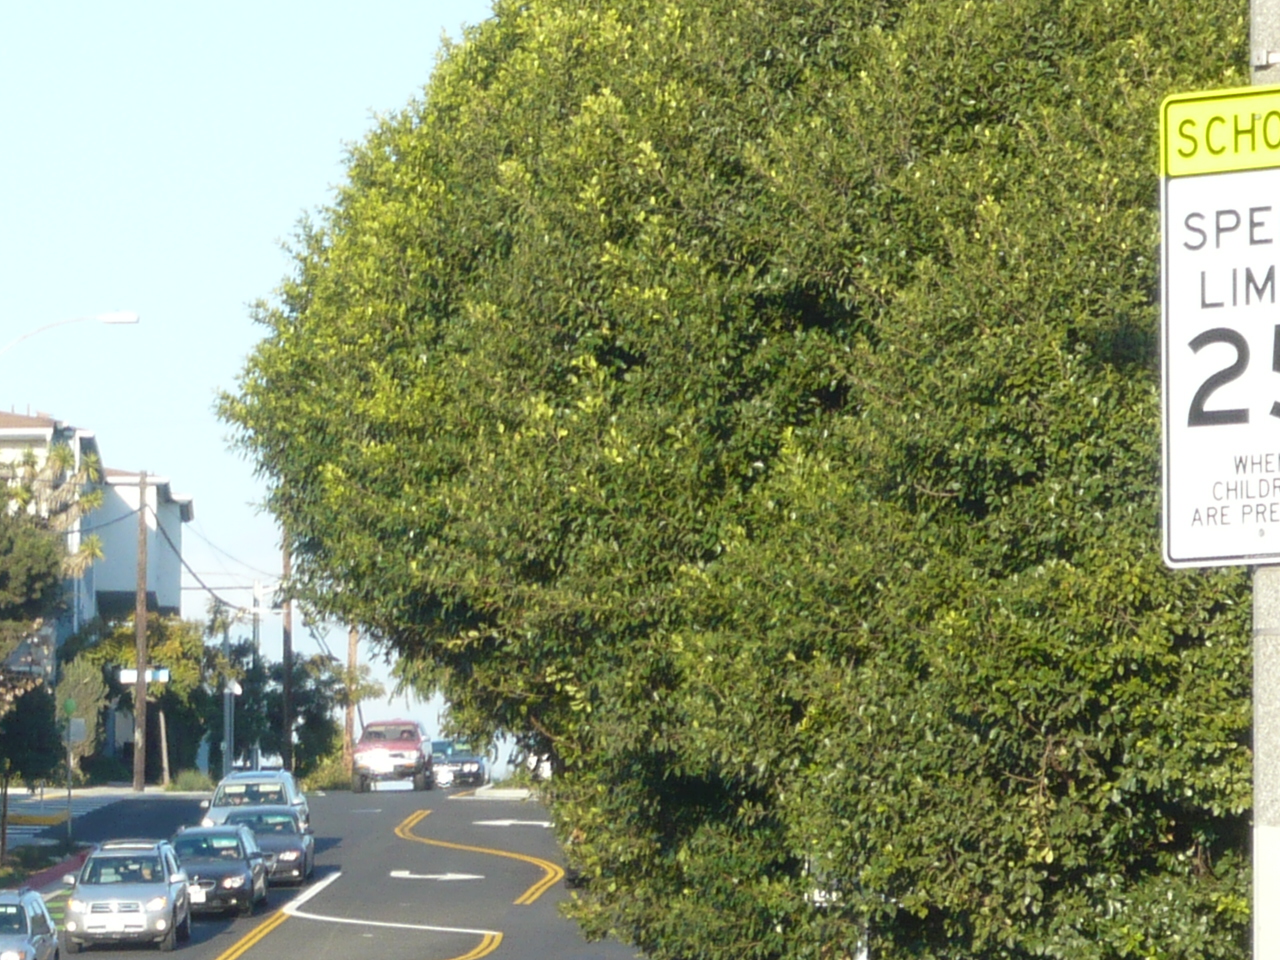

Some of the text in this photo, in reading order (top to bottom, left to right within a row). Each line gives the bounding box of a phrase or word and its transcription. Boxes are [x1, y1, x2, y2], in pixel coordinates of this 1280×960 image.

[1177, 110, 1280, 158] SCHO
[1183, 205, 1274, 252] SPE
[1200, 264, 1276, 310] LIM
[1187, 324, 1280, 428] 2
[1234, 452, 1280, 475] WHE
[1191, 502, 1280, 527] ARE PRE
